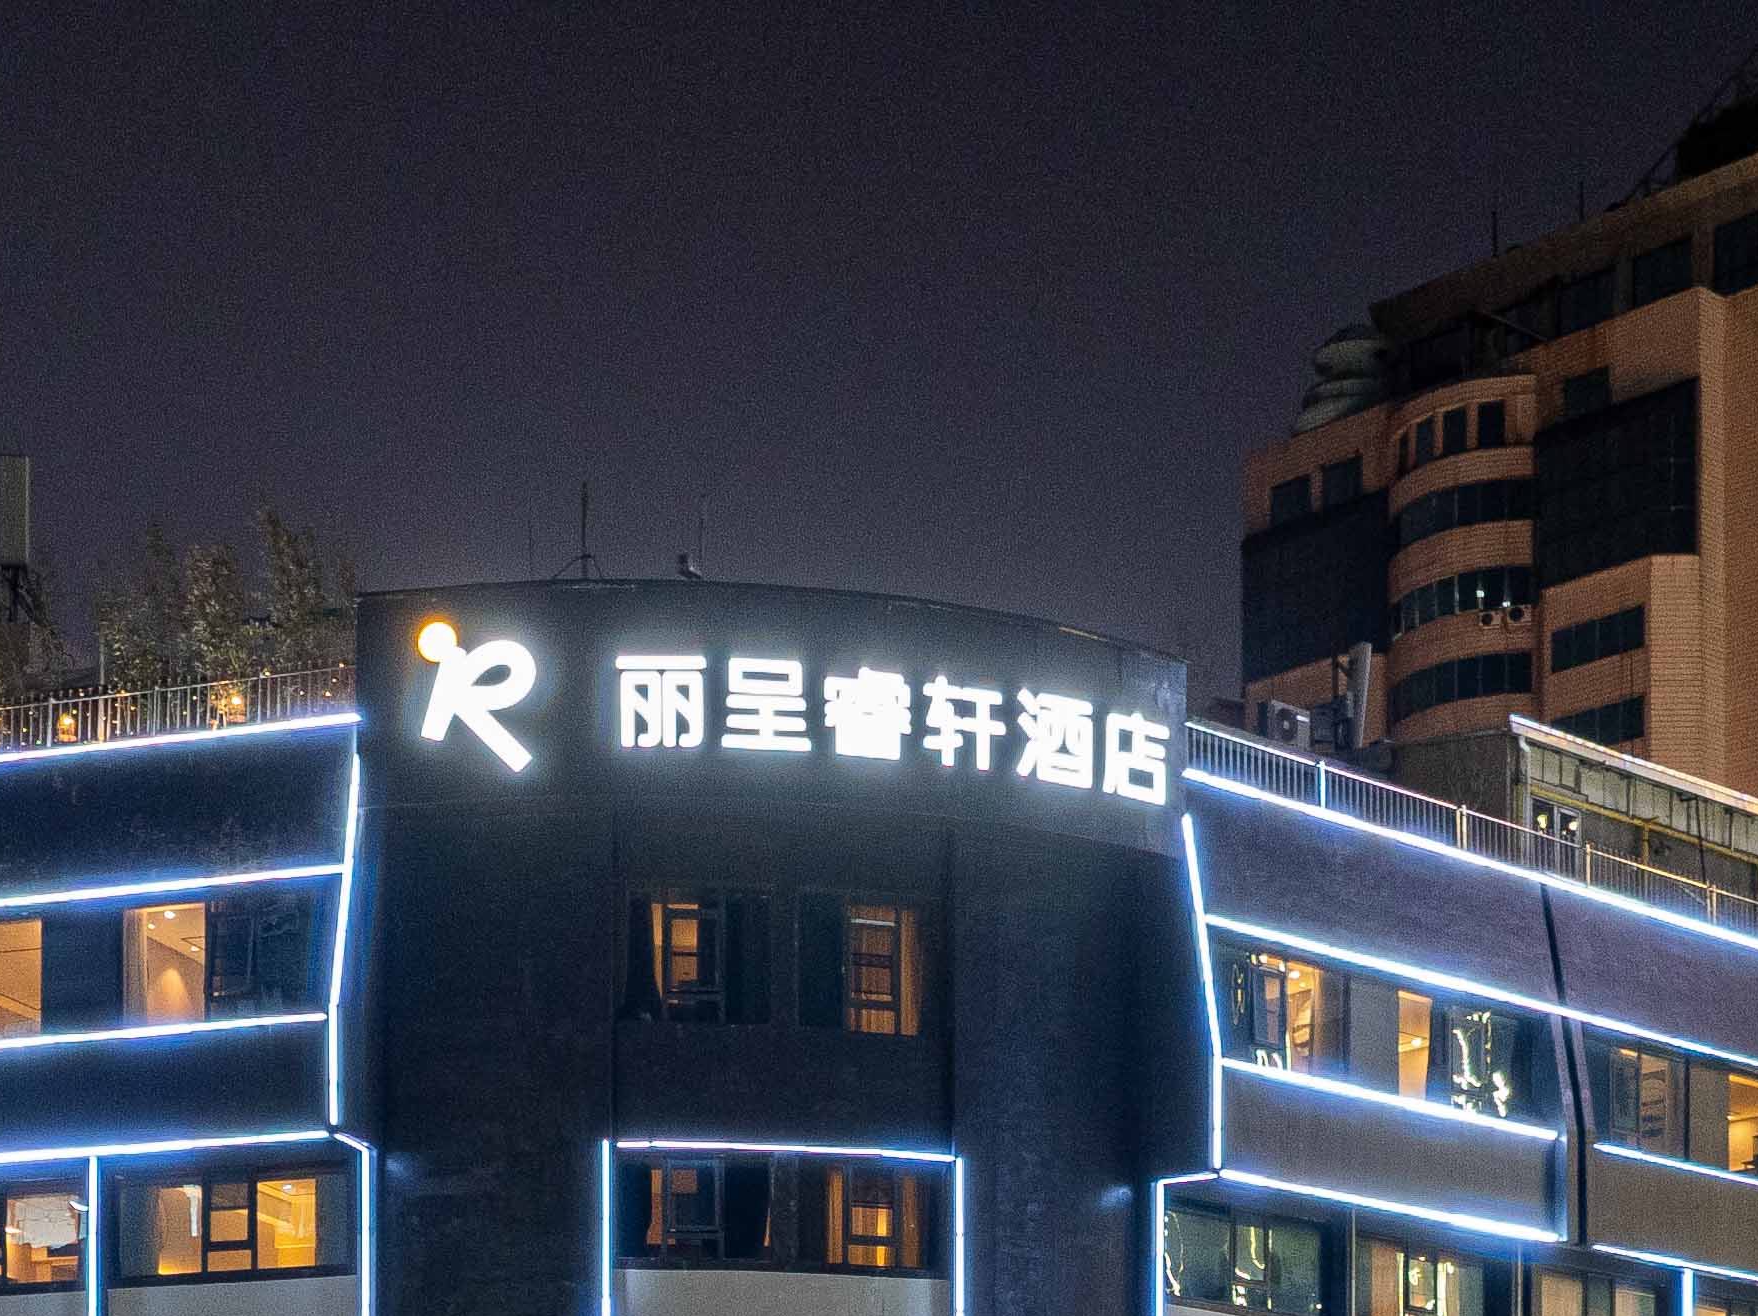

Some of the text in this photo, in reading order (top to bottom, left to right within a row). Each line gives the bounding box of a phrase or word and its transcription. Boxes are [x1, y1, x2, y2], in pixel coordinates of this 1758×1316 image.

[615, 653, 1172, 806] 丽呈睿轩酒店
